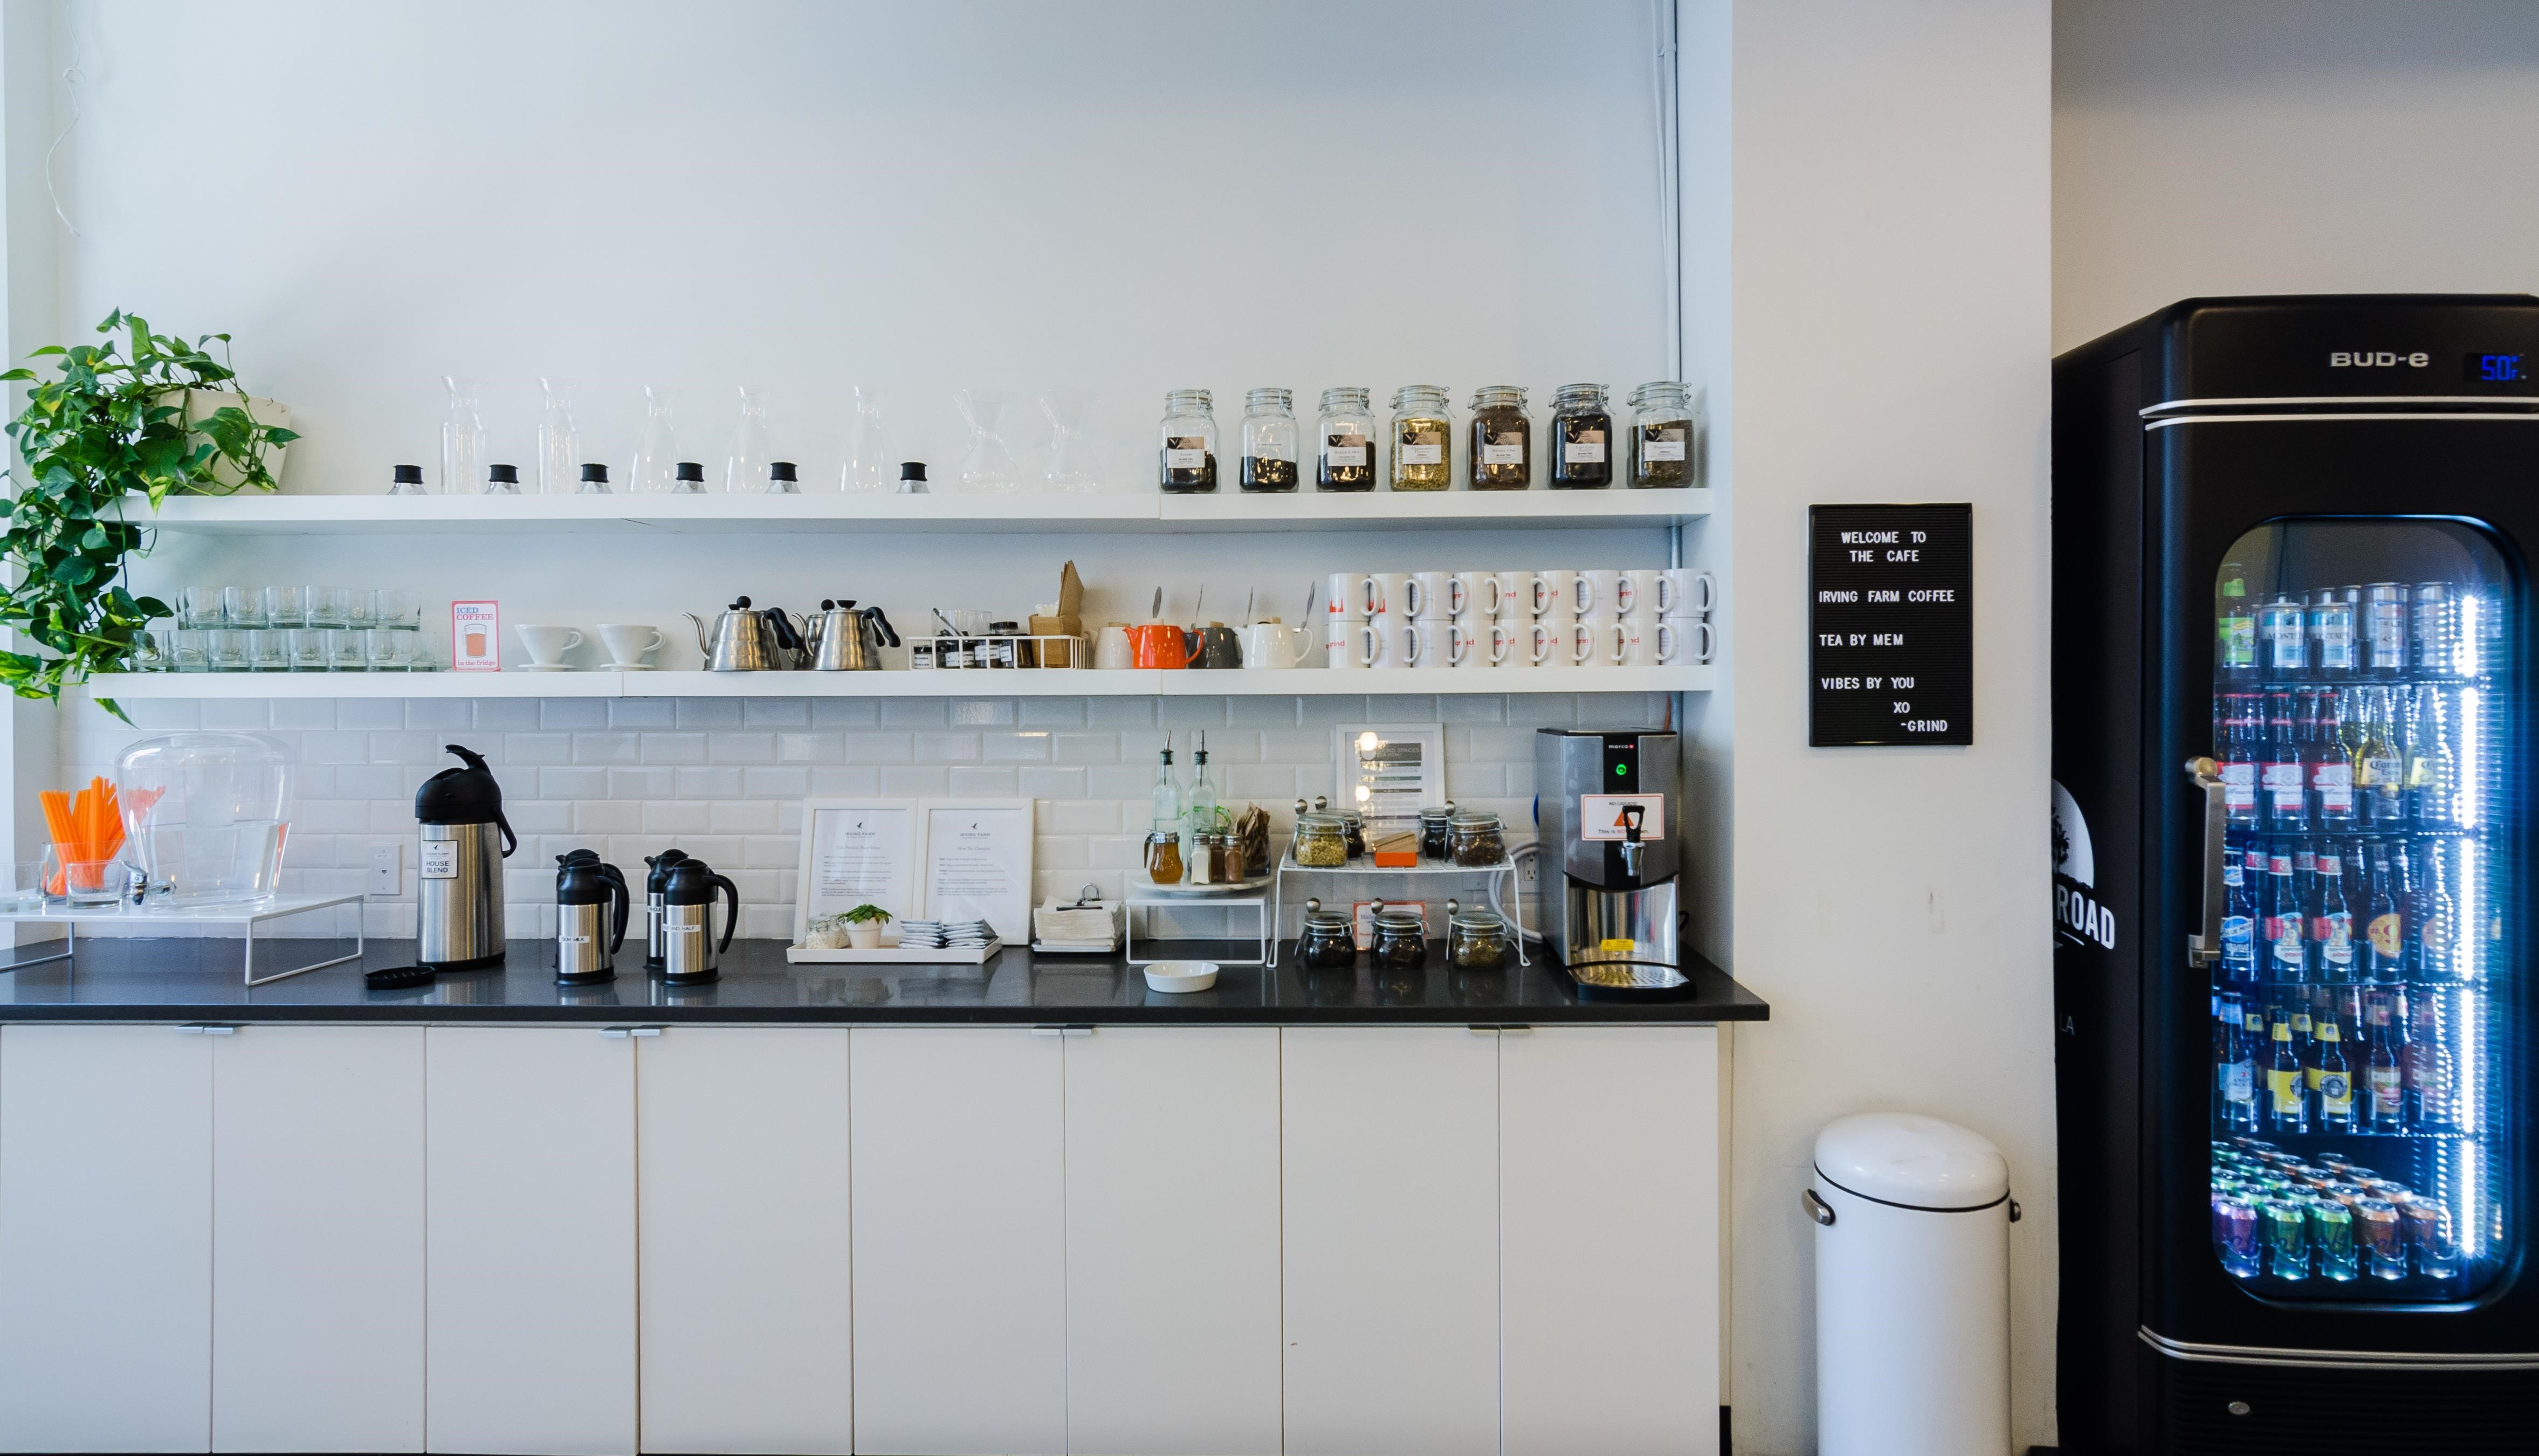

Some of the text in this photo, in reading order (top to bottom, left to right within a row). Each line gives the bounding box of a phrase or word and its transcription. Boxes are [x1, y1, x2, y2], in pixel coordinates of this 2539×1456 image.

[2331, 352, 2428, 367] BUD-e
[1841, 531, 1926, 543] WELCOME TO
[1849, 550, 1919, 562] THE CAFE
[1819, 590, 1955, 603] IRVING FARM COFFEE
[1819, 634, 1903, 646] TEA BY MEM
[1821, 677, 1915, 689] VIBES BY YOU
[1894, 702, 1910, 714] XO
[2056, 883, 2115, 950] ROAD
